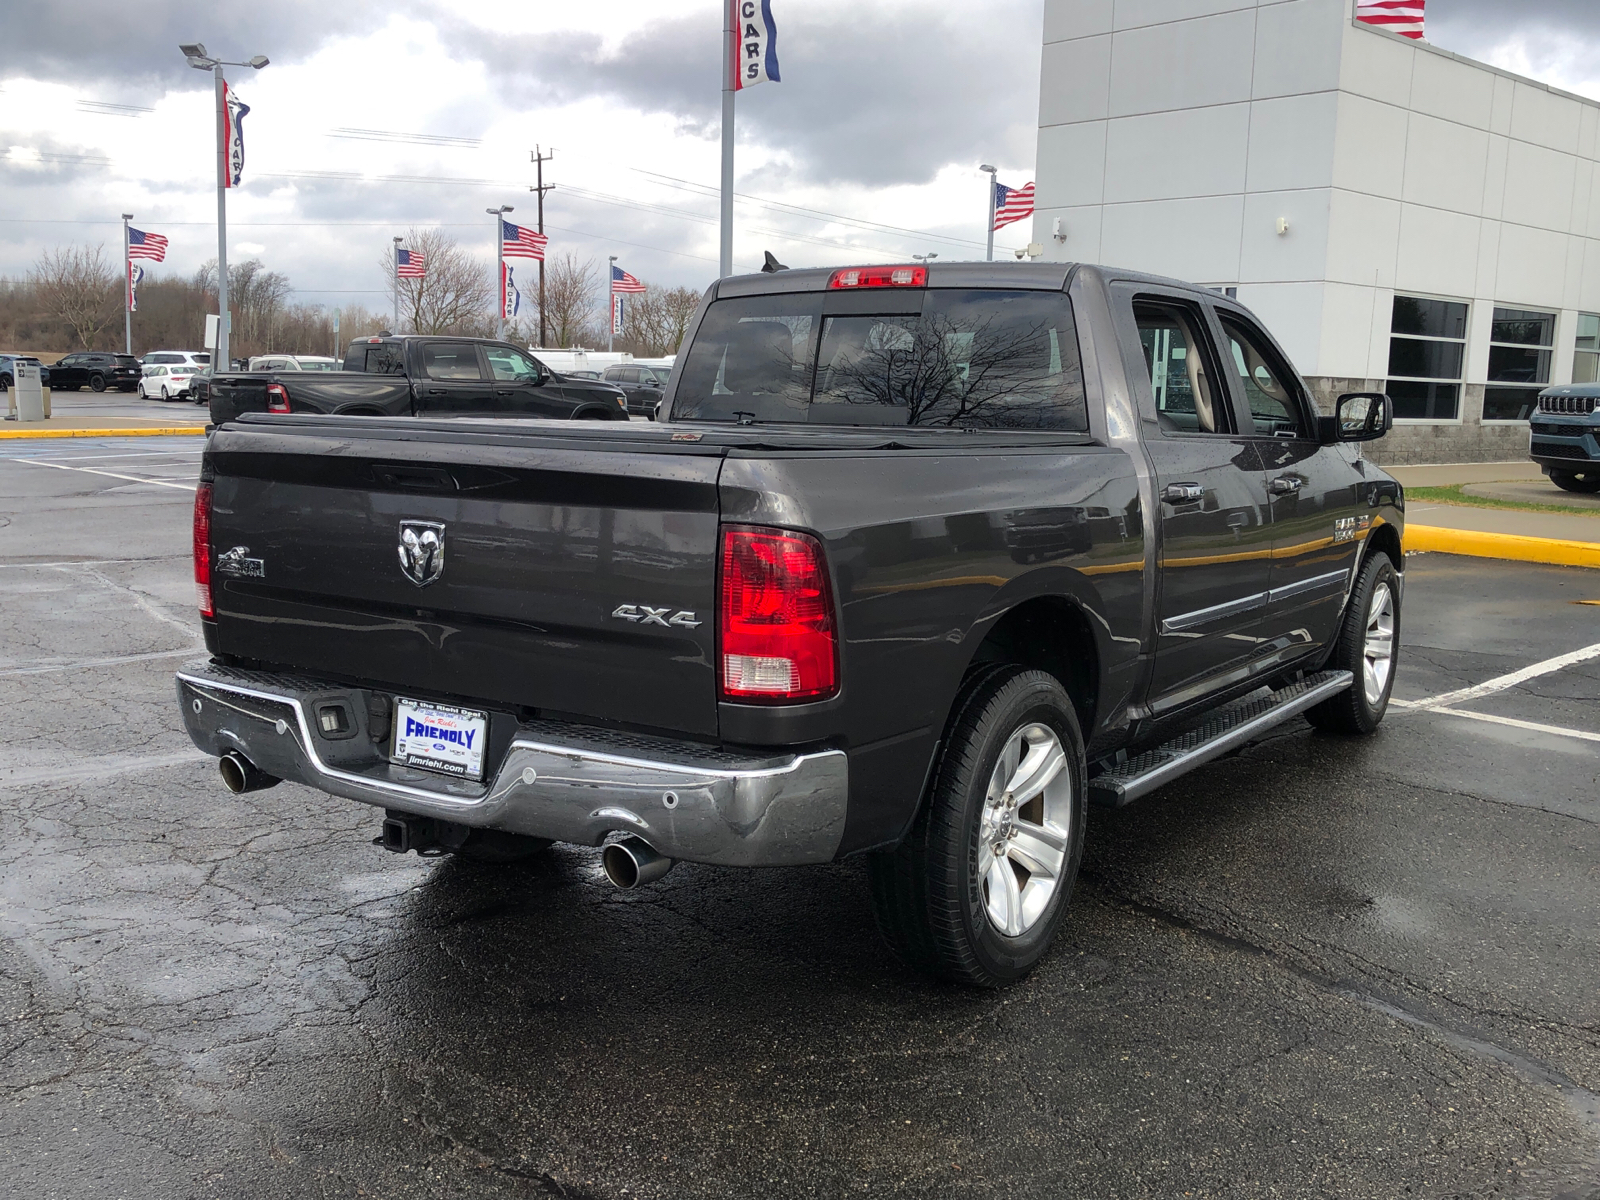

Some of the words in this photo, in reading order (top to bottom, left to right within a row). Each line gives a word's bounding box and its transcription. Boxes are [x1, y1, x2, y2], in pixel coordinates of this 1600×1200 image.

[742, 2, 760, 79] CARS
[233, 138, 241, 179] CAR
[406, 716, 476, 750] FRIENDLY
[424, 716, 436, 724] Jim
[437, 718, 457, 728] Riehl's
[408, 755, 464, 773] jimriehl.com
